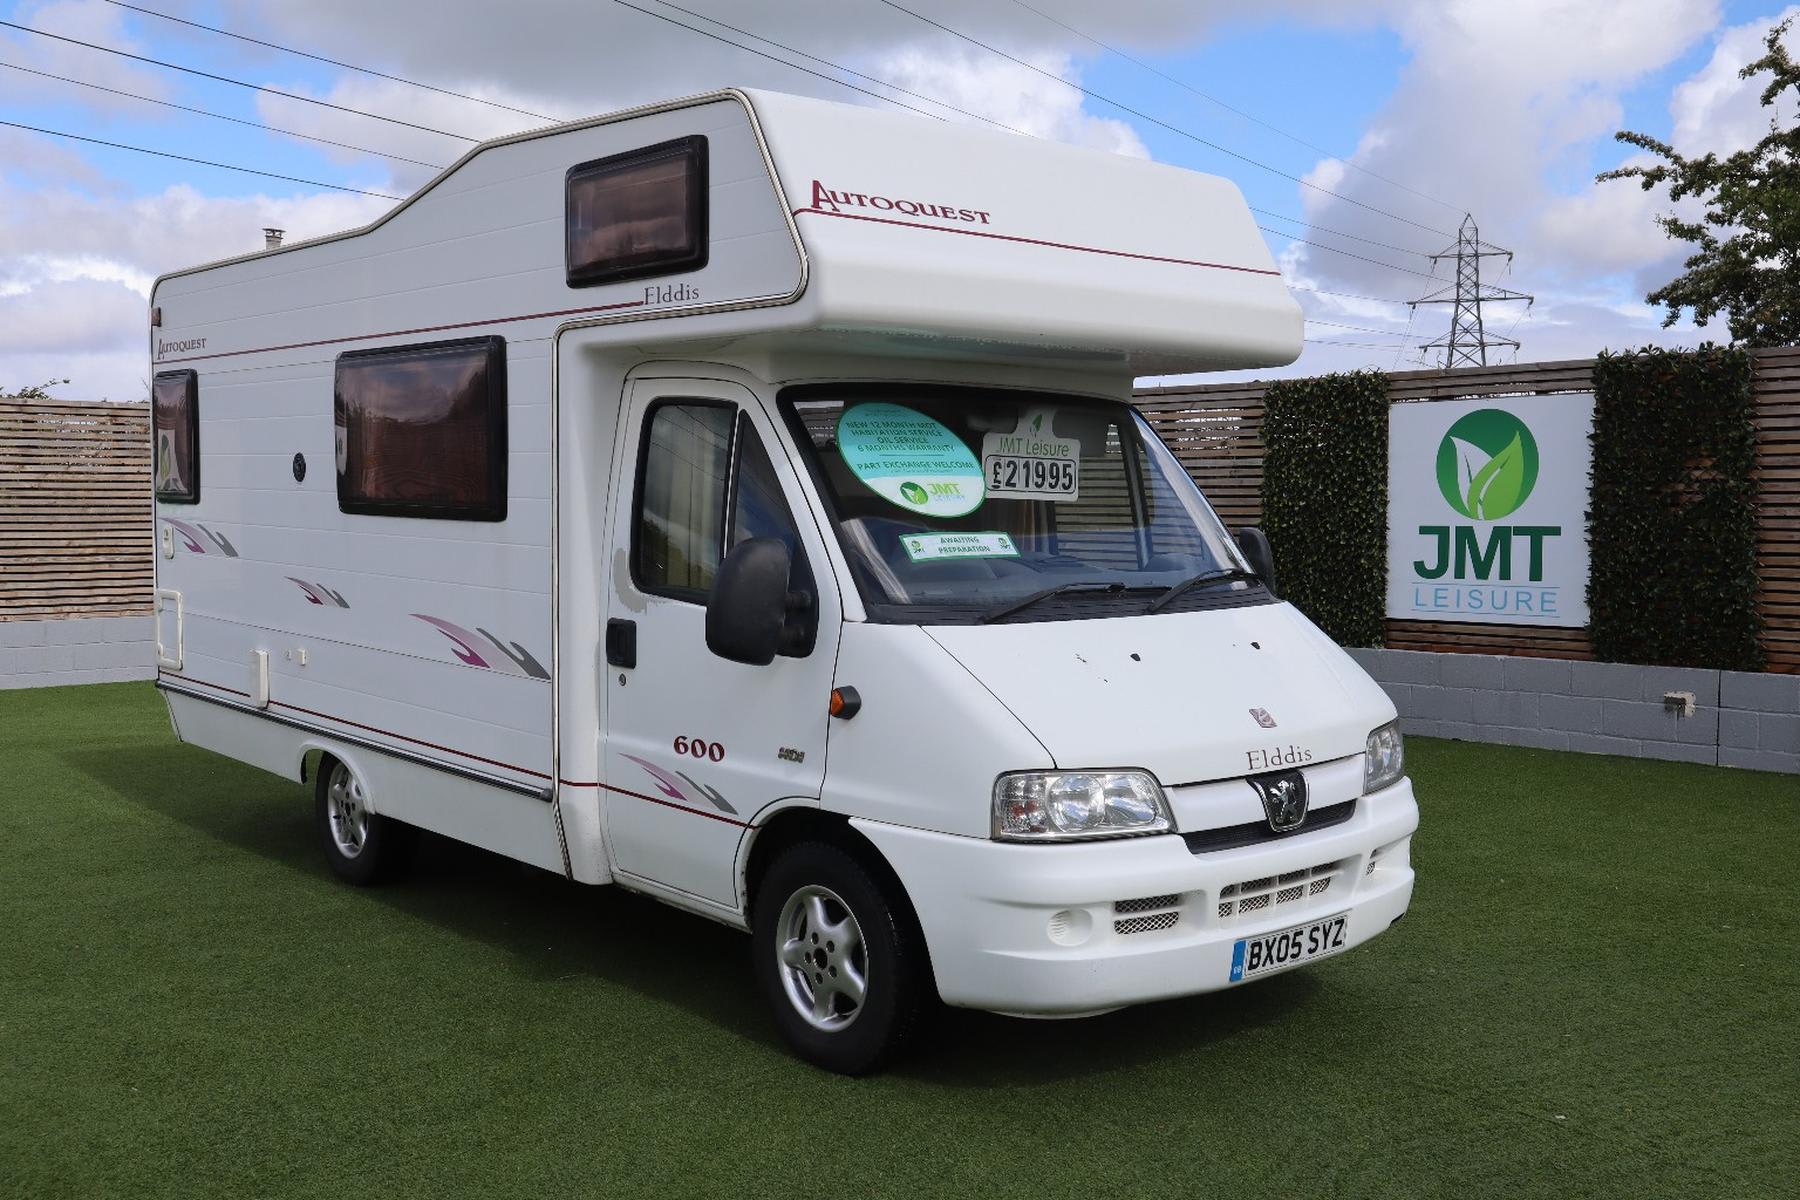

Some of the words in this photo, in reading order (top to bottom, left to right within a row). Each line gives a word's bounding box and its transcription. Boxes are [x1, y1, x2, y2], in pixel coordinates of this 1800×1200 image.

[811, 180, 990, 224] AUTOQUEST
[644, 283, 700, 305] Elddis
[157, 338, 207, 360] AUTOQUEST
[846, 421, 868, 429] NEW
[908, 429, 943, 437] SERVICE
[909, 444, 955, 452] WARRANTY
[996, 437, 1023, 454] JMT
[1026, 440, 1070, 457] Leisure
[857, 462, 881, 470] PART
[883, 461, 931, 469] EXCHANGE
[932, 460, 974, 469] WELCOME
[991, 460, 1073, 490] £21995
[927, 482, 961, 495] JMT
[938, 545, 991, 554] PREPARATION
[940, 536, 980, 544] AWAITING
[1413, 525, 1562, 582] JMT
[1415, 588, 1558, 613] LEISURE
[673, 735, 725, 762] 600
[1246, 745, 1313, 770] Elddis
[1247, 930, 1304, 971] BX05
[1307, 918, 1345, 955] SYZ
